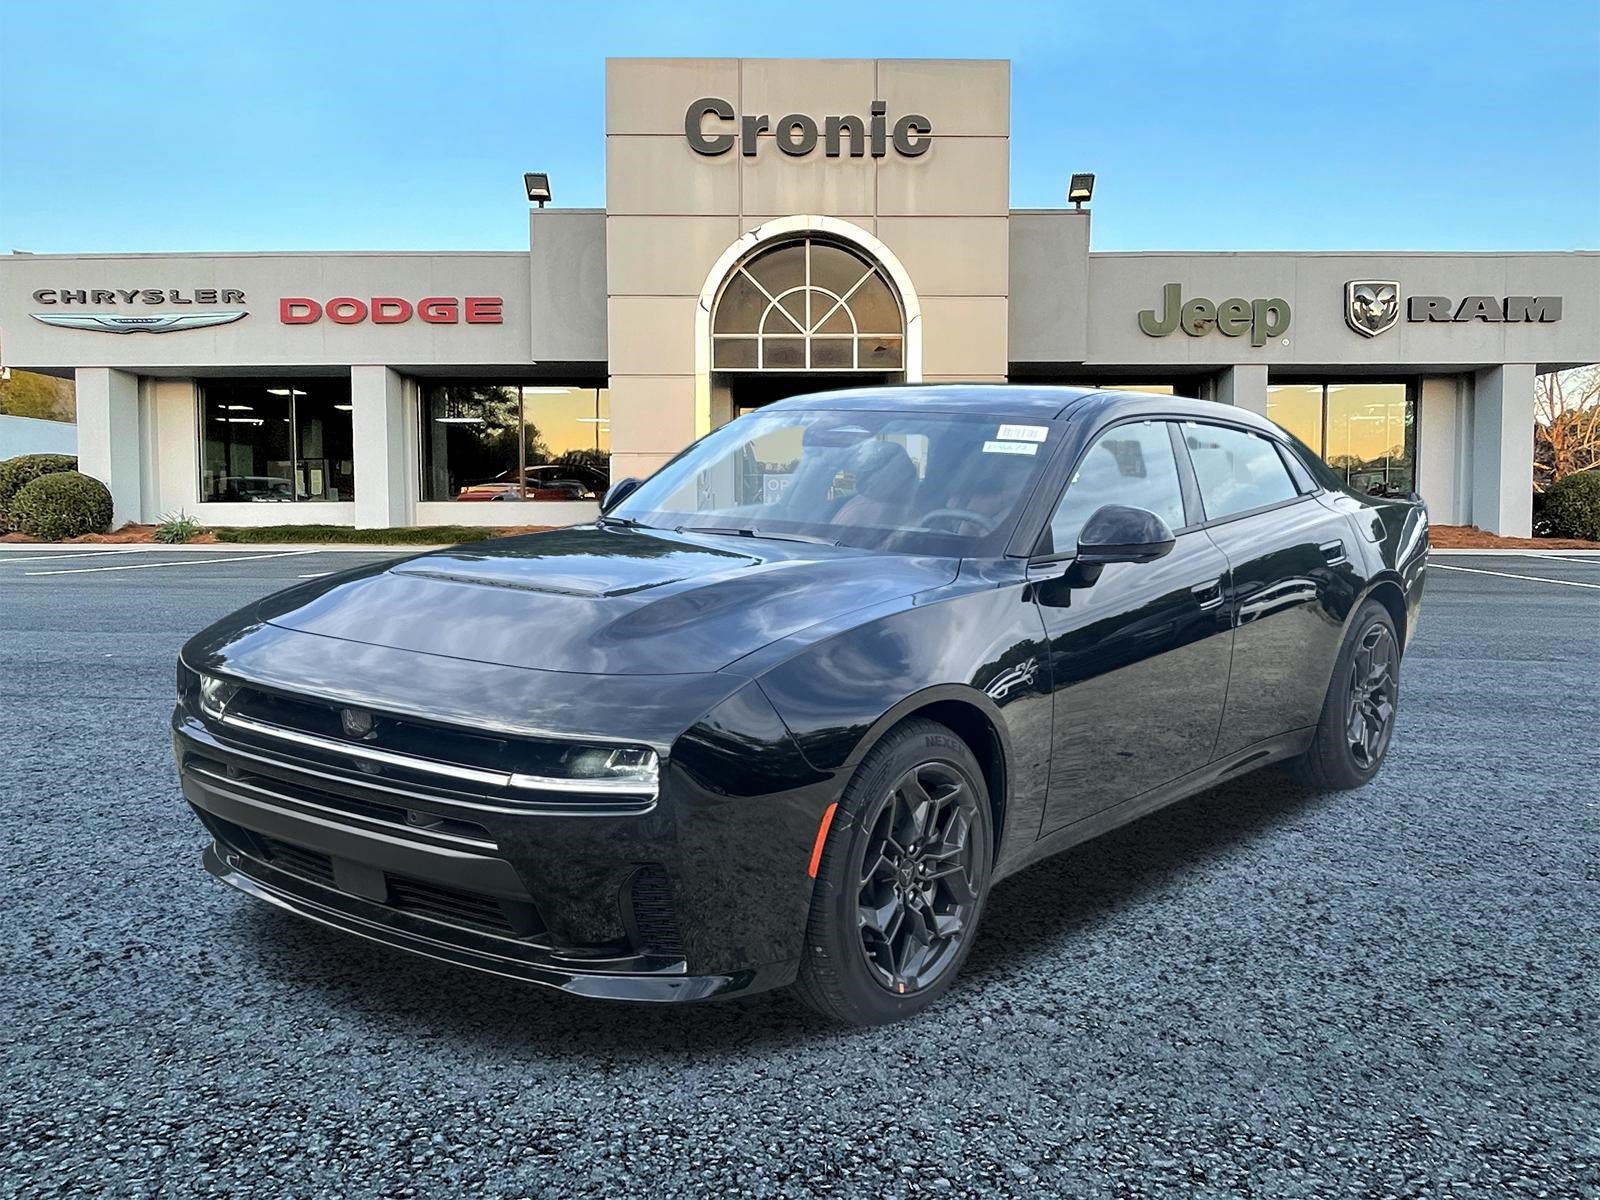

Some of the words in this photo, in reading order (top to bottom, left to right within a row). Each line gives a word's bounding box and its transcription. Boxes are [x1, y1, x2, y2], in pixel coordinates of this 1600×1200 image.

[684, 97, 932, 158] Cronic
[32, 288, 246, 304] CHRYSLER
[1407, 296, 1563, 323] RAM
[279, 297, 503, 324] DODGE
[1138, 283, 1291, 347] Jeep
